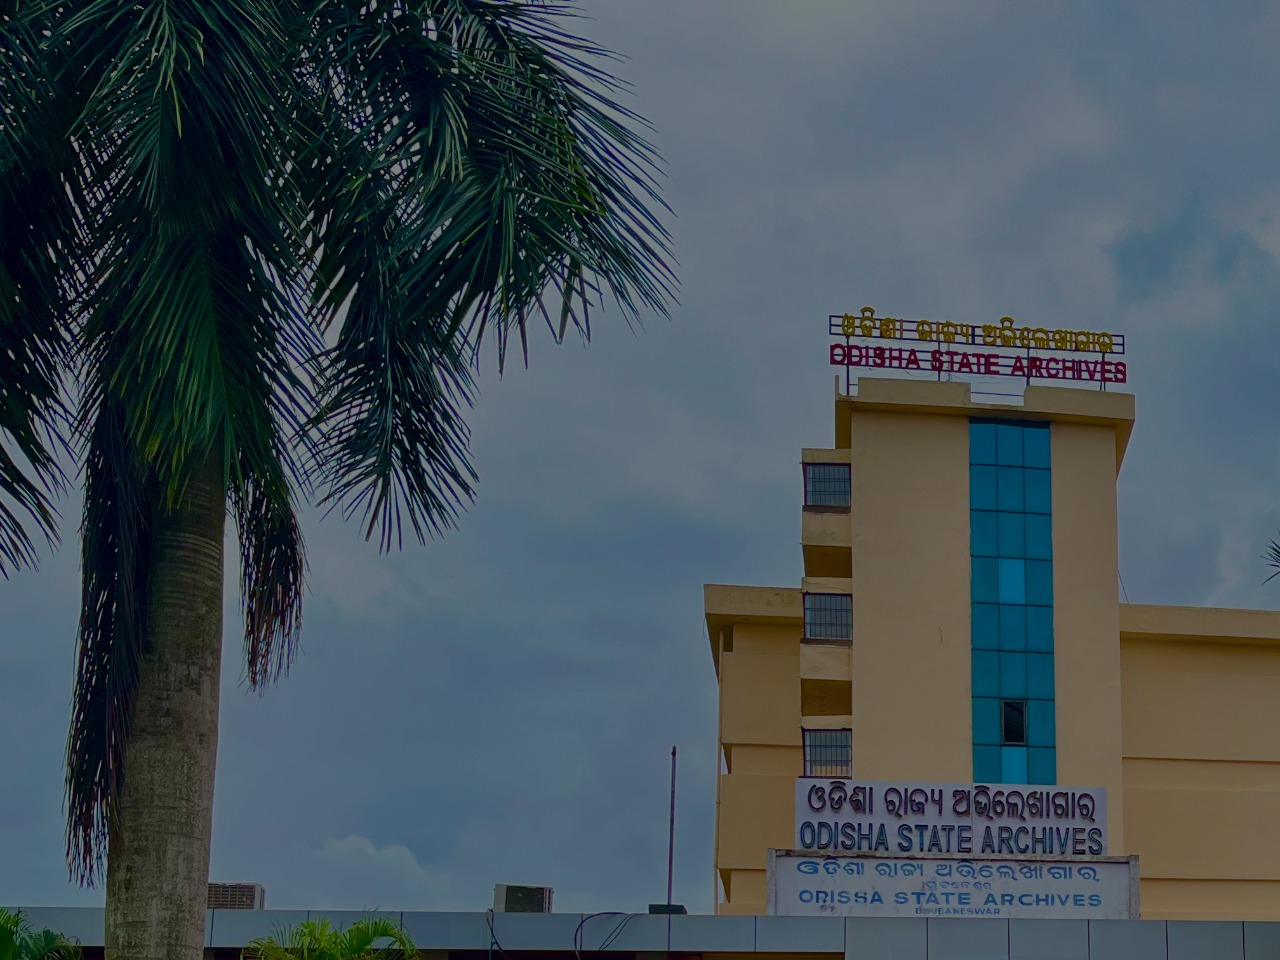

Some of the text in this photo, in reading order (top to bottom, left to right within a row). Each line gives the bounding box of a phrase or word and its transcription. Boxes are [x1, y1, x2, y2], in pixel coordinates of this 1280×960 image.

[830, 343, 1127, 383] ODISHA STATE ARCHIVES
[883, 787, 943, 819] ରାଜ୍ୟ
[952, 786, 1096, 823] ଅଭିଲେଖାଗାର
[800, 821, 1104, 856] ODISHA STATE ARCHIVES
[798, 889, 1102, 909] ORISSA STATE ARCHIVES
[915, 907, 1001, 917] BHUBANESWAR
